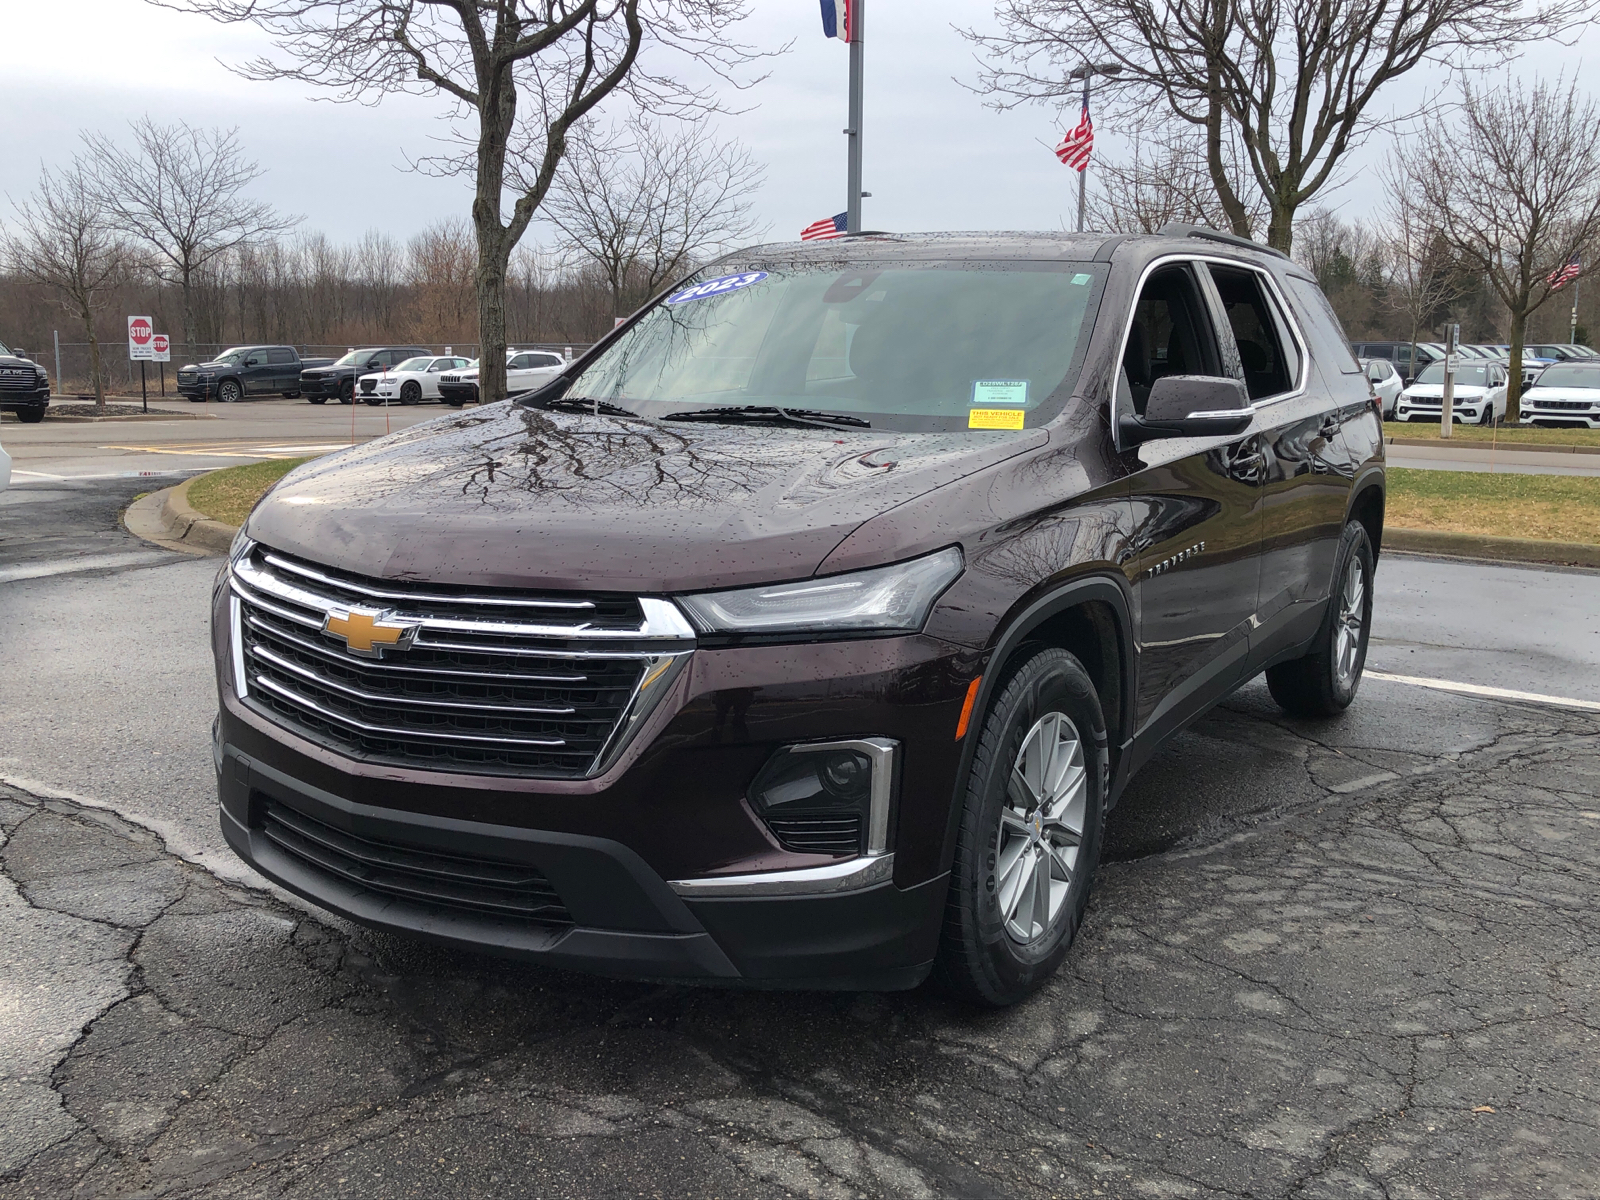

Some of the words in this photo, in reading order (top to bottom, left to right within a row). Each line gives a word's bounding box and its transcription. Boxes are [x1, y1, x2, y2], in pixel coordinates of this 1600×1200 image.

[674, 273, 761, 302] 2023
[131, 327, 150, 337] STOP
[1147, 541, 1206, 579] TRAVERSE
